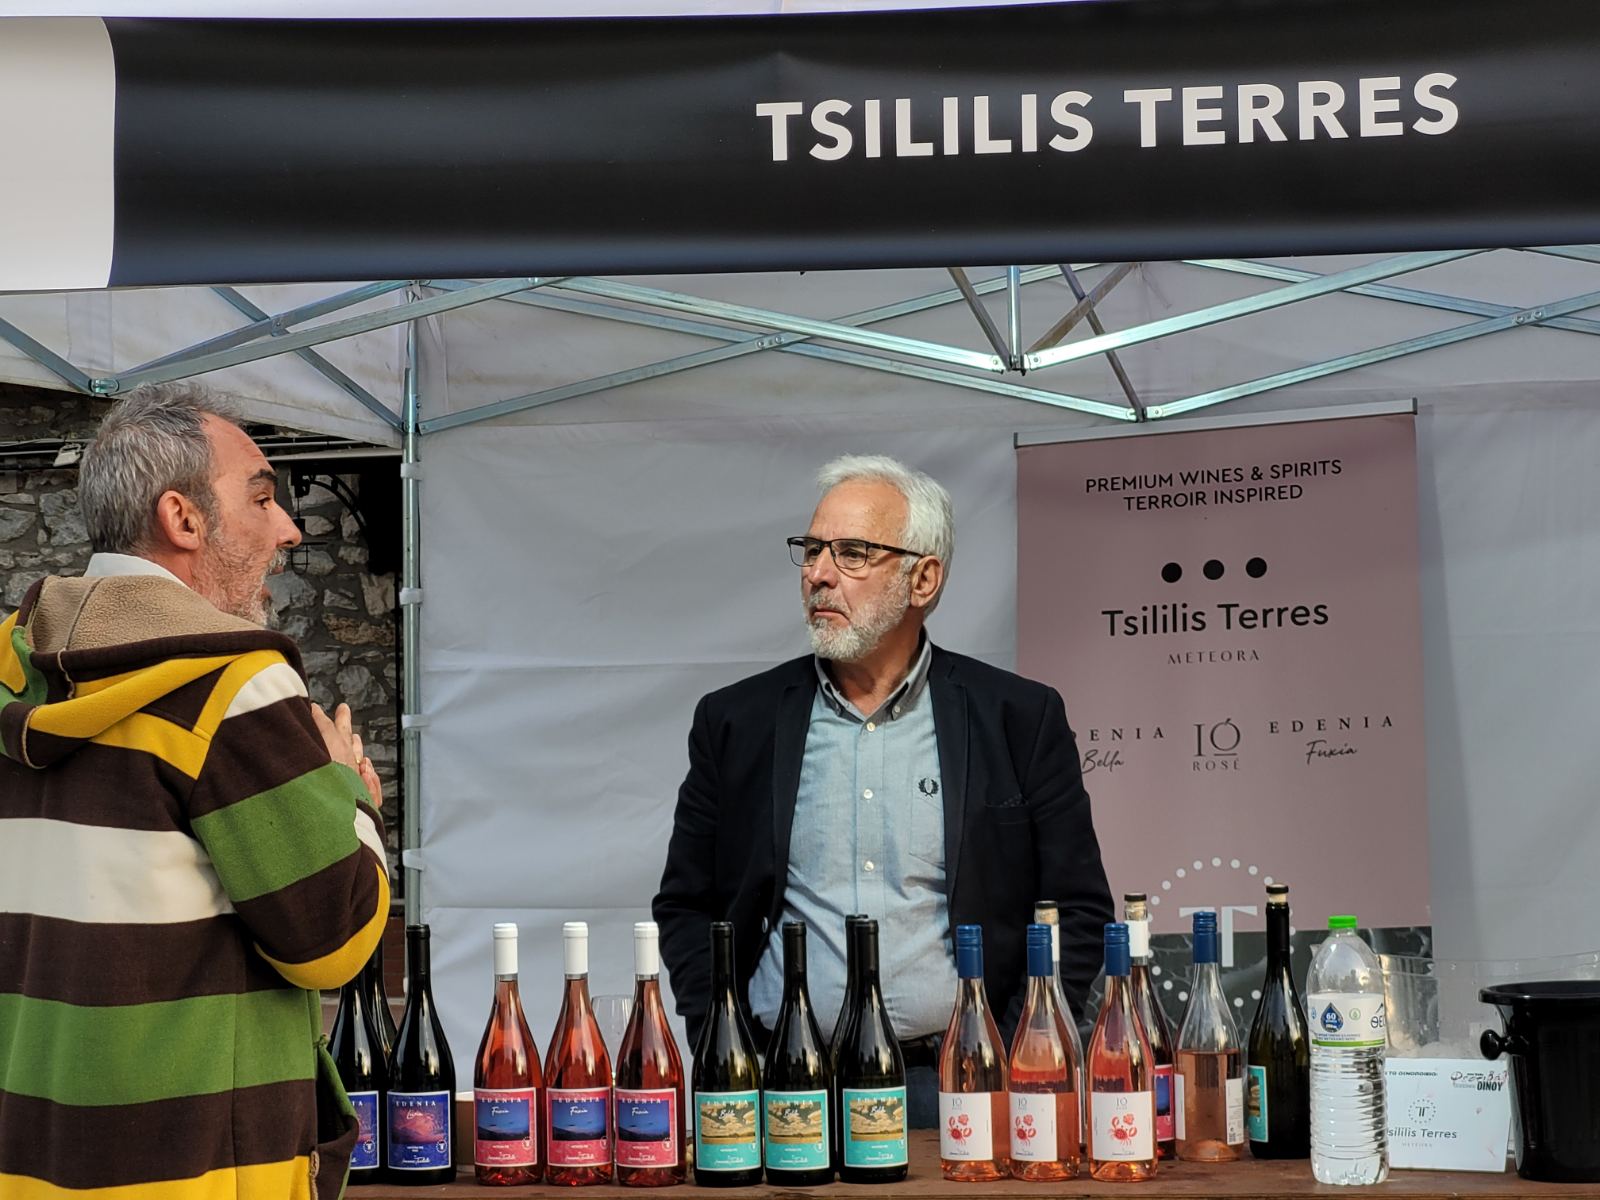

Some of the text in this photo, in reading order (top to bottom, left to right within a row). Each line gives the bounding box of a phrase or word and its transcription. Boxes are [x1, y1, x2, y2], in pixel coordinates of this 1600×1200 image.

[755, 72, 1460, 162] TSILILIS TERRES
[1085, 459, 1343, 494] PREMIUM WINES & SPIRITS
[1123, 483, 1304, 511] TERROIR INSPIRED
[1101, 603, 1330, 637] Tsililis Terres
[1168, 649, 1261, 665] METEORA
[1070, 726, 1165, 743] ENIA
[1269, 714, 1394, 734] EDENIA
[1081, 749, 1125, 775] Bella
[1305, 738, 1358, 765] Fuxia
[1326, 1012, 1337, 1020] 60
[1385, 1126, 1458, 1139] sililis Terres
